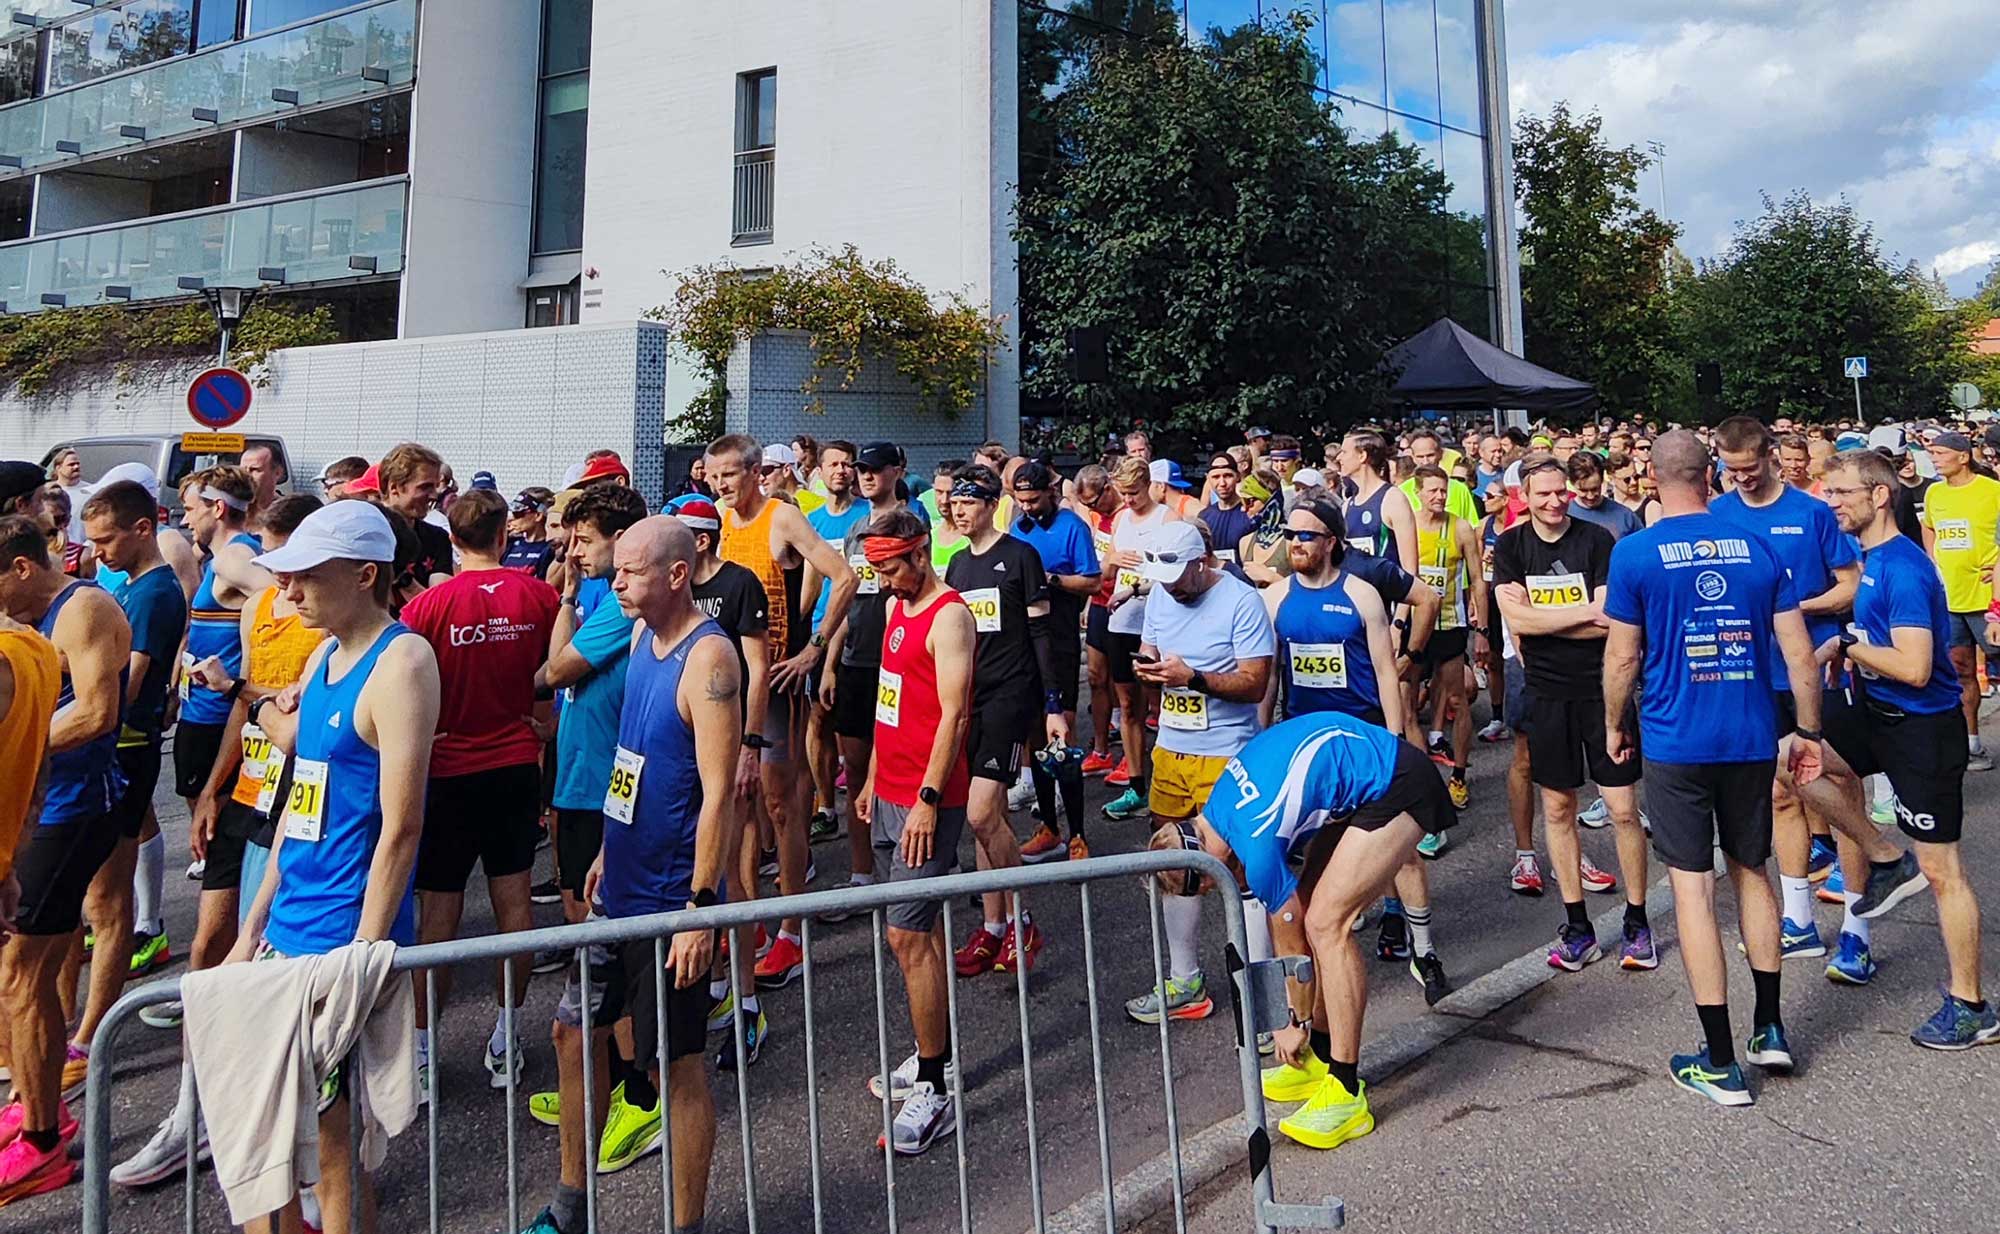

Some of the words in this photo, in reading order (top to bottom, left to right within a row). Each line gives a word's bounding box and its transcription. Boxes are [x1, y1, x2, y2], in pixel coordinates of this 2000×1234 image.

[856, 566, 875, 580] 83
[1531, 586, 1582, 604] 2719
[693, 597, 723, 618] NING
[488, 617, 509, 625] TATA
[488, 624, 535, 634] CONSULTANCY
[488, 633, 520, 641] SERVICES
[1718, 631, 1752, 641] renta
[1293, 656, 1341, 673] 2436
[1162, 692, 1202, 713] 2983
[610, 768, 635, 799] 95
[1893, 794, 1936, 831] ORG
